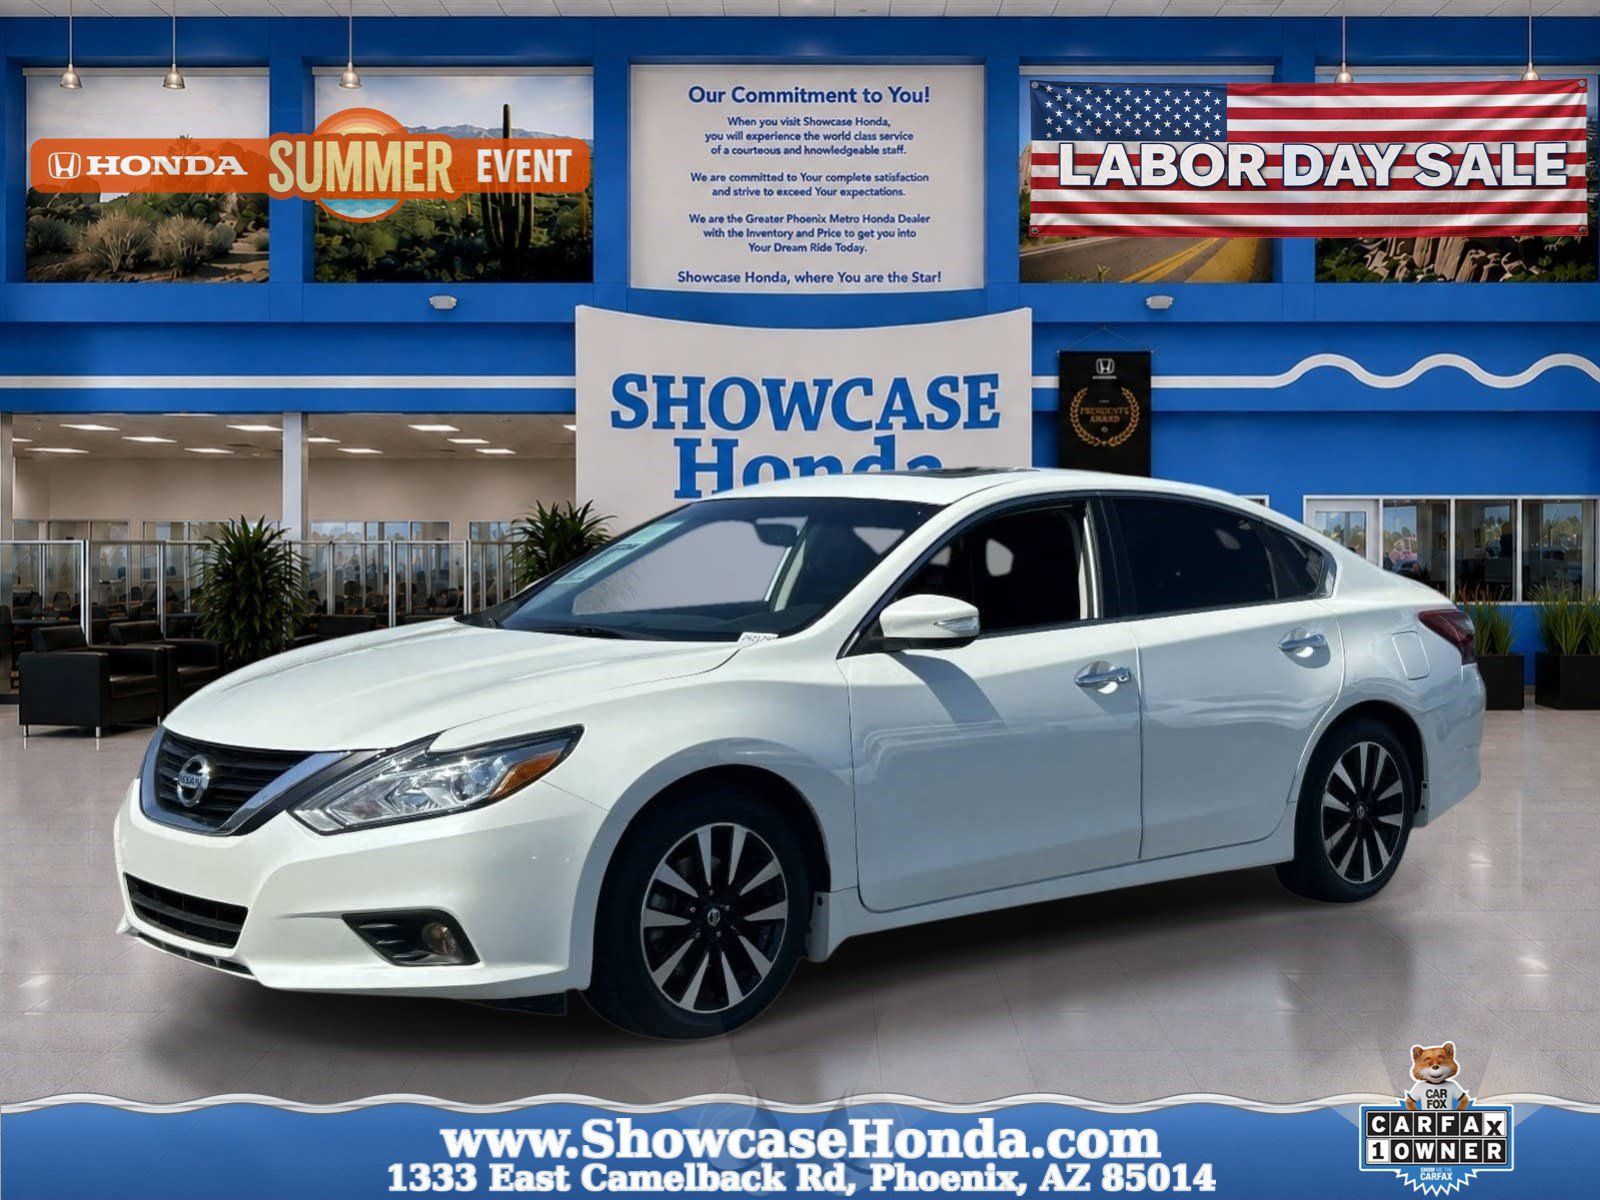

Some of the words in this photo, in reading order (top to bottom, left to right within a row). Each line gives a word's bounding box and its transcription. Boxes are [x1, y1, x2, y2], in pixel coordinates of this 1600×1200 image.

[688, 85, 727, 104] Our
[731, 85, 858, 104] Commitment
[861, 87, 884, 104] to
[887, 85, 930, 104] You!
[727, 116, 757, 127] When
[759, 118, 778, 129] you
[779, 116, 801, 127] visit
[803, 116, 853, 127] Showcase
[855, 116, 891, 129] Honda,
[704, 133, 724, 143] you
[725, 130, 744, 141] will
[745, 131, 802, 143] experience
[803, 130, 821, 141] the
[822, 130, 852, 141] world
[853, 130, 878, 141] class
[879, 130, 914, 141] service
[710, 144, 722, 155] of
[723, 147, 730, 155] a
[731, 146, 782, 155] courteous
[783, 144, 802, 155] and
[882, 144, 907, 155] staff.
[86, 155, 248, 176] HONDA
[268, 139, 455, 194] SUMMER
[477, 148, 572, 183] EVENT
[1058, 142, 1268, 188] LABOR
[1281, 142, 1406, 188] DAY
[1414, 142, 1569, 188] SALE
[690, 172, 708, 182] We
[709, 174, 727, 182] are
[728, 172, 784, 182] committed
[786, 173, 798, 182] to
[799, 172, 823, 182] Your
[825, 172, 872, 185] complete
[874, 171, 930, 182] satisfaction
[711, 186, 731, 197] and
[732, 186, 761, 197] strive
[763, 187, 775, 197] to
[776, 186, 813, 197] exceed
[814, 186, 838, 197] Your
[839, 186, 907, 199] expectations.
[688, 213, 707, 224] We
[708, 216, 725, 224] are
[726, 213, 744, 224] the
[745, 213, 785, 224] Greater
[786, 213, 827, 224] Phoenix
[829, 213, 860, 224] Metro
[862, 213, 896, 224] Honda
[897, 213, 931, 224] Dealer
[703, 227, 726, 238] with
[727, 227, 745, 238] the
[746, 228, 795, 241] Inventory
[796, 227, 815, 238] and
[816, 227, 842, 238] Price
[844, 229, 856, 238] to
[857, 229, 875, 241] get
[876, 230, 896, 241] you
[897, 228, 917, 238] into
[748, 242, 772, 253] Your
[773, 242, 808, 253] Dream
[809, 242, 833, 253] Ride
[834, 242, 868, 255] Today.
[677, 270, 741, 284] Showcase
[744, 271, 791, 285] Honda,
[794, 270, 835, 284] where
[837, 271, 861, 284] You
[863, 274, 884, 284] are
[887, 271, 909, 284] the
[911, 271, 942, 284] Star!
[610, 373, 1001, 431] SHOWCASE
[674, 434, 943, 500] Hond
